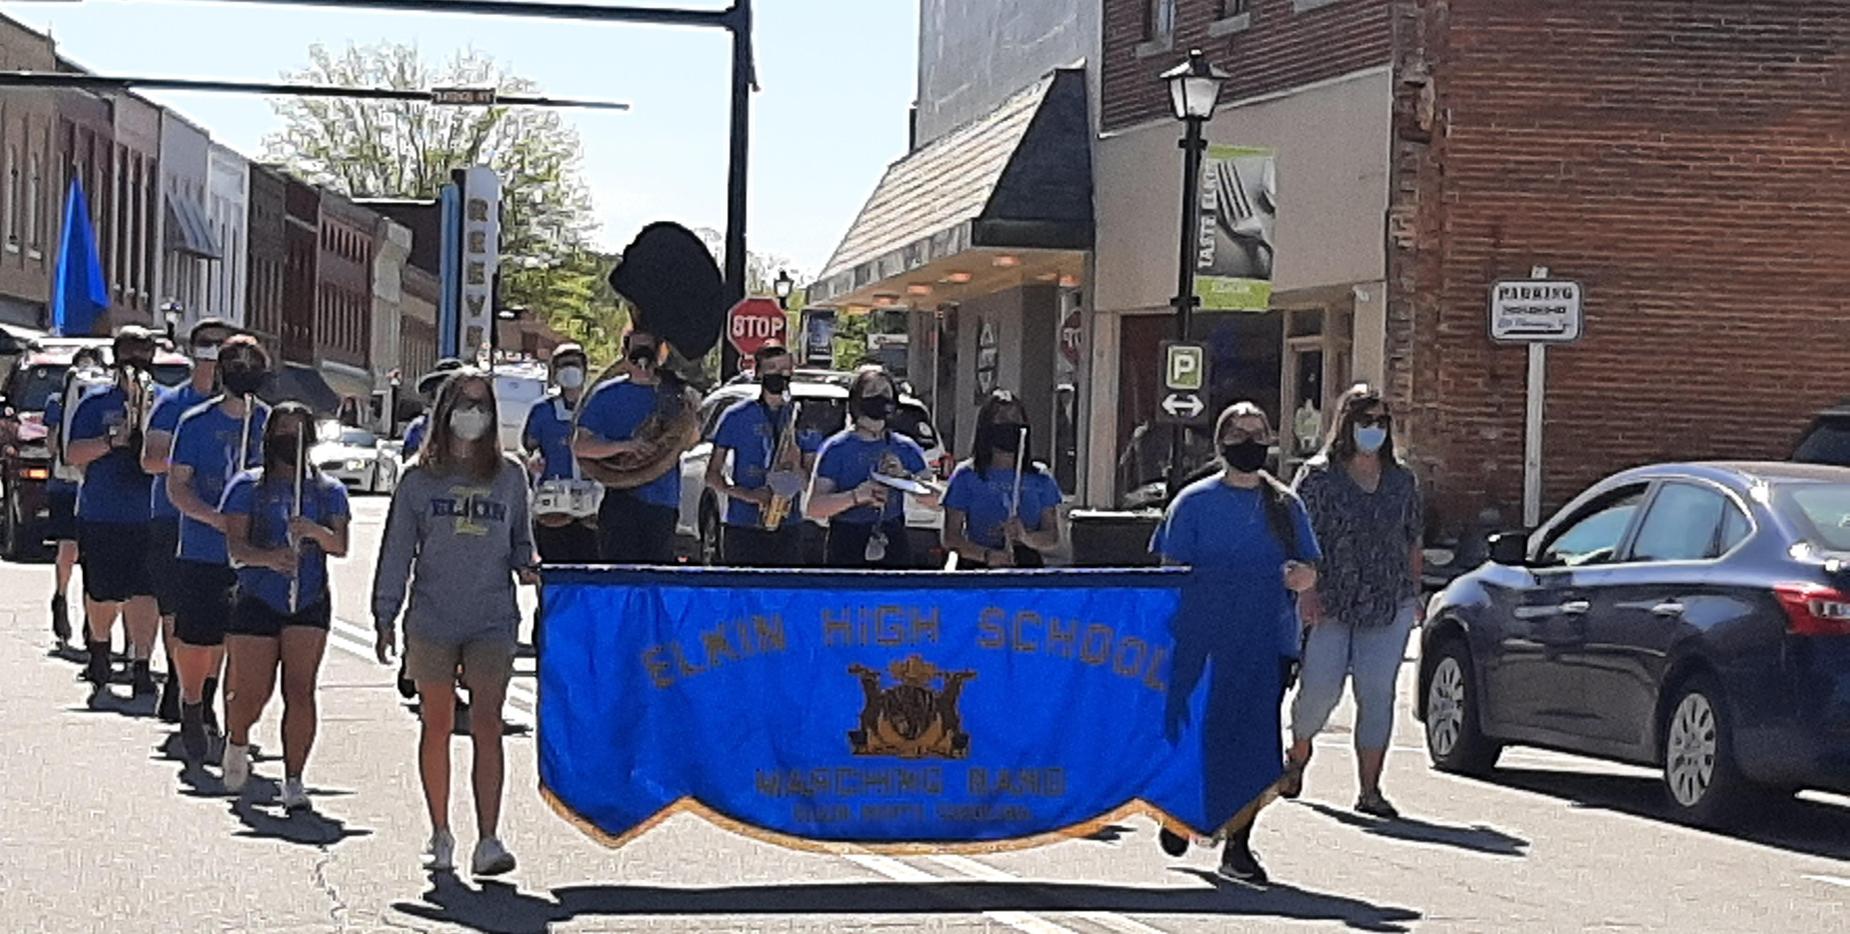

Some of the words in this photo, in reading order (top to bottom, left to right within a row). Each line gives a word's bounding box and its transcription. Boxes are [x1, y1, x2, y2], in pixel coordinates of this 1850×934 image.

[1197, 214, 1216, 268] TASTE
[1499, 287, 1573, 300] PARKING
[733, 315, 784, 338] STOP
[1173, 354, 1195, 381] P
[642, 612, 787, 689] ELKIN
[822, 605, 941, 648] HIGH
[977, 606, 1168, 693] SCHOOL
[755, 768, 942, 796] MARCHING
[967, 768, 1066, 797] BAND
